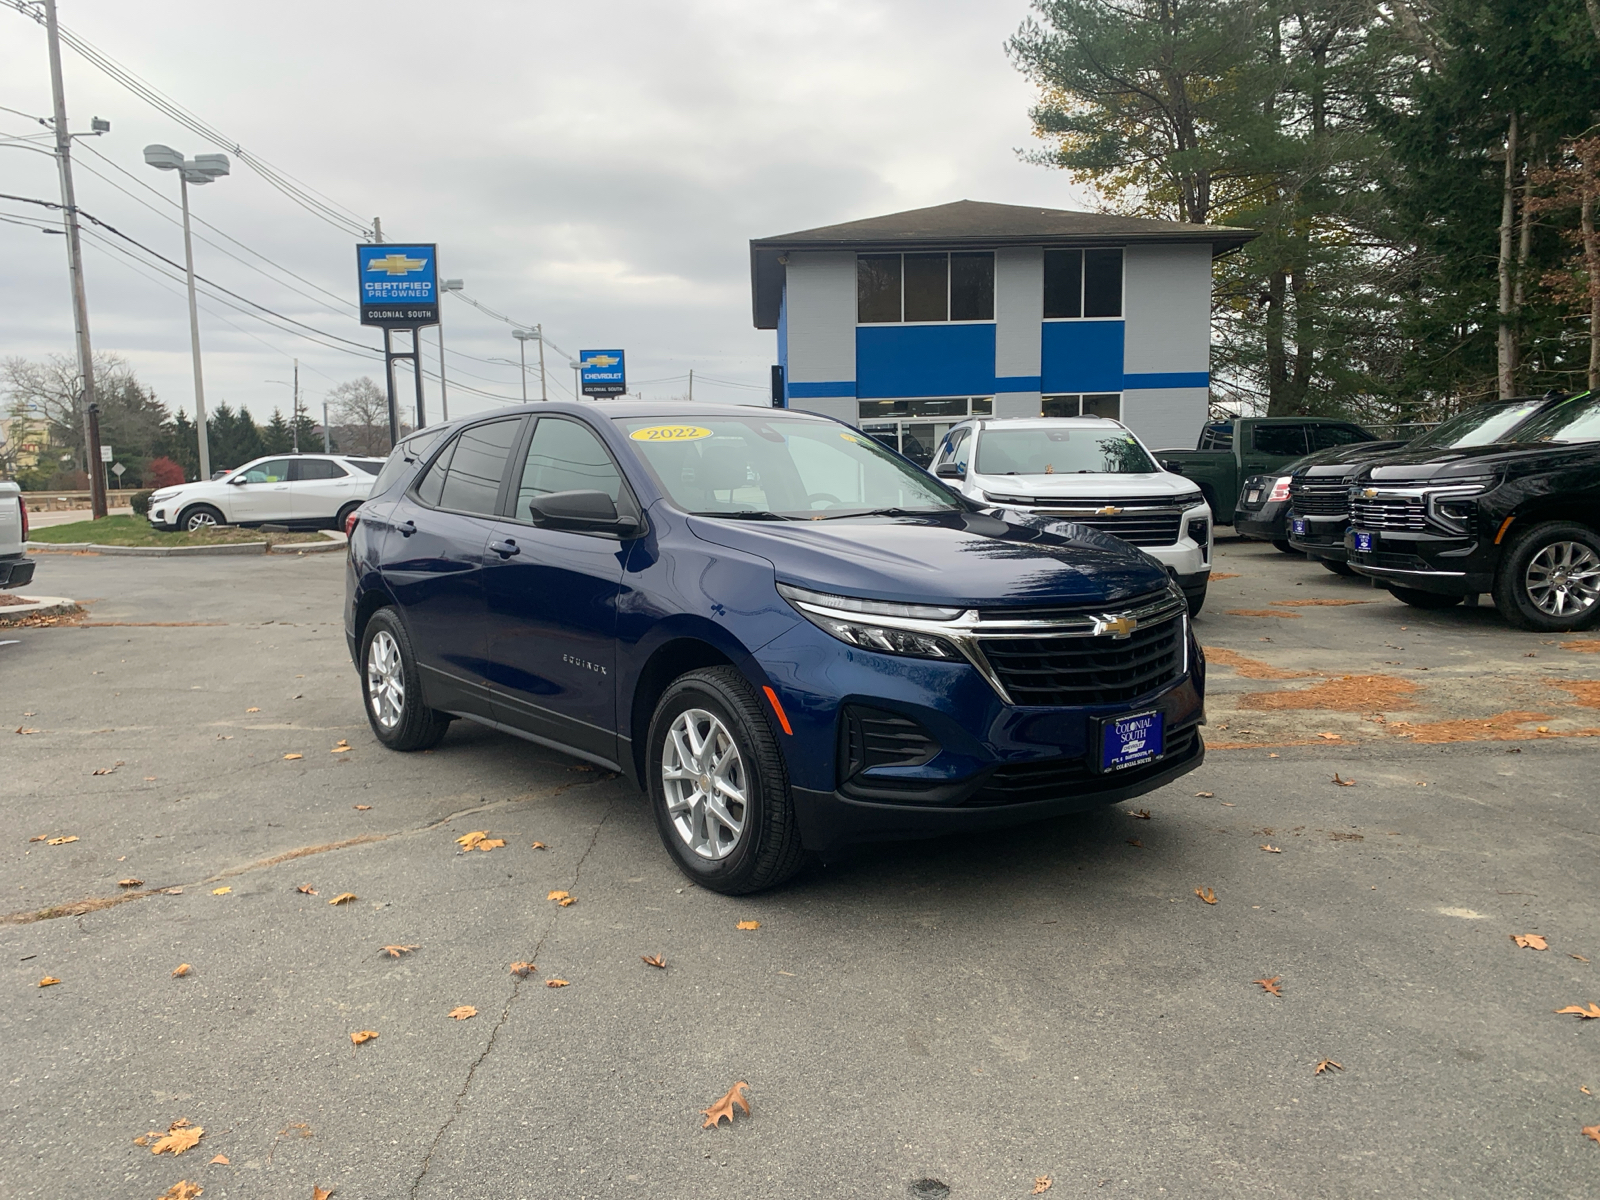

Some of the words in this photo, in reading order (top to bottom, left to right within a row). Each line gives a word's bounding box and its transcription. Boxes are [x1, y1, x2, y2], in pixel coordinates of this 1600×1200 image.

[365, 282, 432, 290] CERTIFIED
[408, 310, 431, 318] SOUTH
[647, 427, 700, 440] 2022
[563, 653, 607, 675] EQUINOX
[1116, 718, 1152, 734] COLONIAL
[1121, 729, 1146, 743] SOUTH
